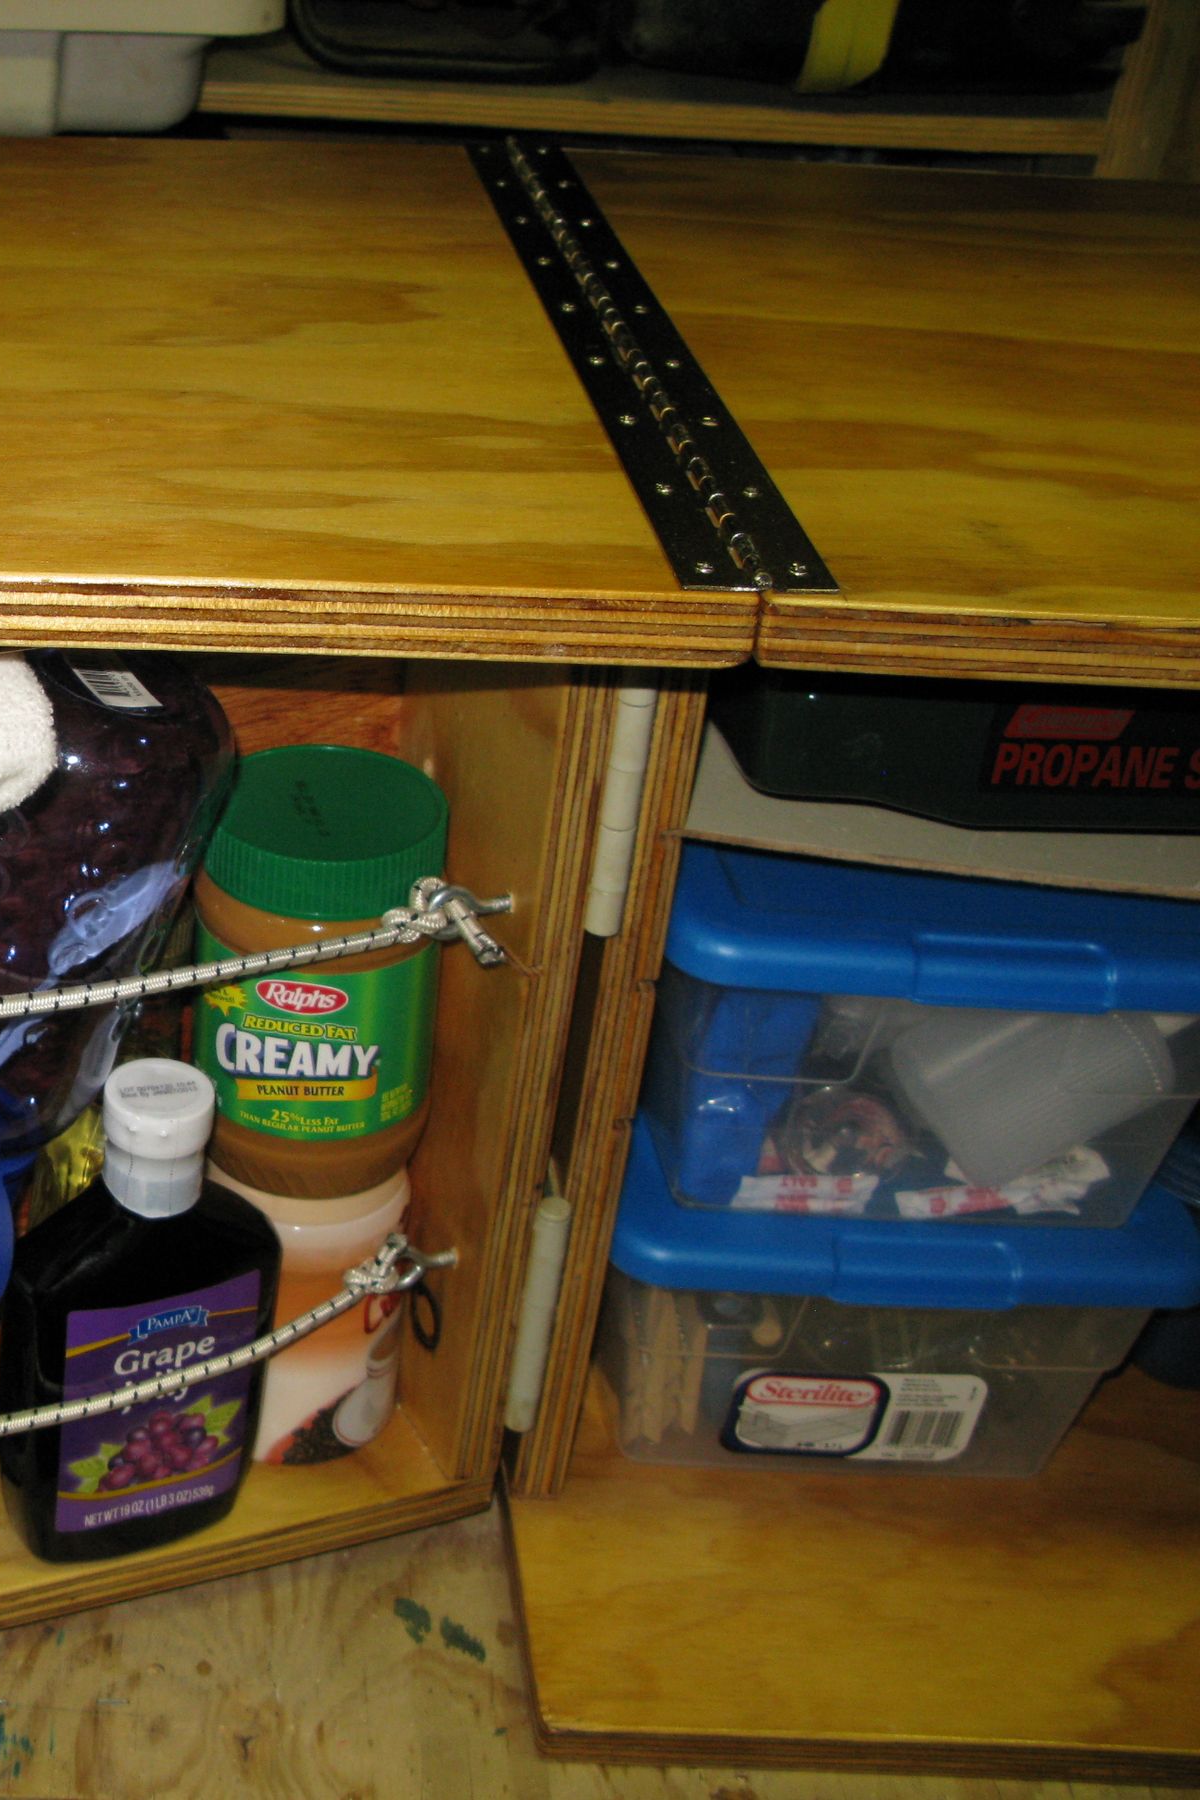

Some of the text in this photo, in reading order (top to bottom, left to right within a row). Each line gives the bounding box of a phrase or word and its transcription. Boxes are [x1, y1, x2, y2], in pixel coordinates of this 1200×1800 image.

[990, 742, 1181, 789] PROPANE
[265, 982, 338, 1011] Ralphs
[243, 1014, 357, 1041] REDUCED FAT
[215, 1022, 379, 1078] CREAMY
[257, 1083, 345, 1096] PEANUT BUTTER
[271, 1109, 300, 1123] 25%
[301, 1124, 335, 1133] PEANUT
[336, 1121, 365, 1132] BUTTER
[114, 1335, 216, 1377] Grape
[759, 1378, 864, 1404] Sterilite
[84, 1512, 102, 1528] NET
[103, 1507, 120, 1522] WT
[131, 1499, 145, 1513] OZ
